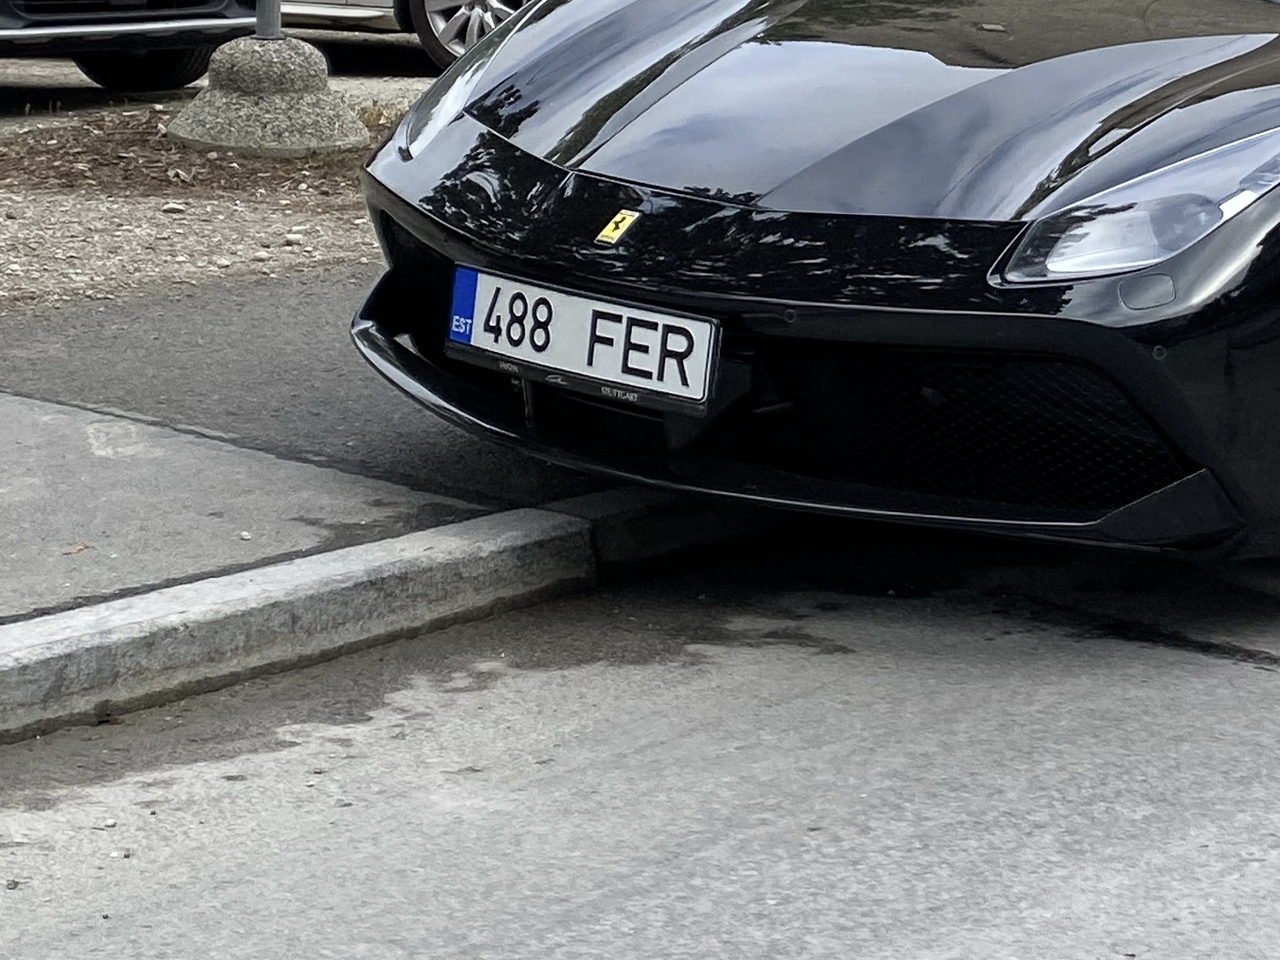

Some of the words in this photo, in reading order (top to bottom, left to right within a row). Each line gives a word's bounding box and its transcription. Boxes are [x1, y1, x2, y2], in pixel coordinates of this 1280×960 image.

[452, 315, 472, 335] EST
[483, 286, 553, 353] 488
[586, 308, 695, 388] FER
